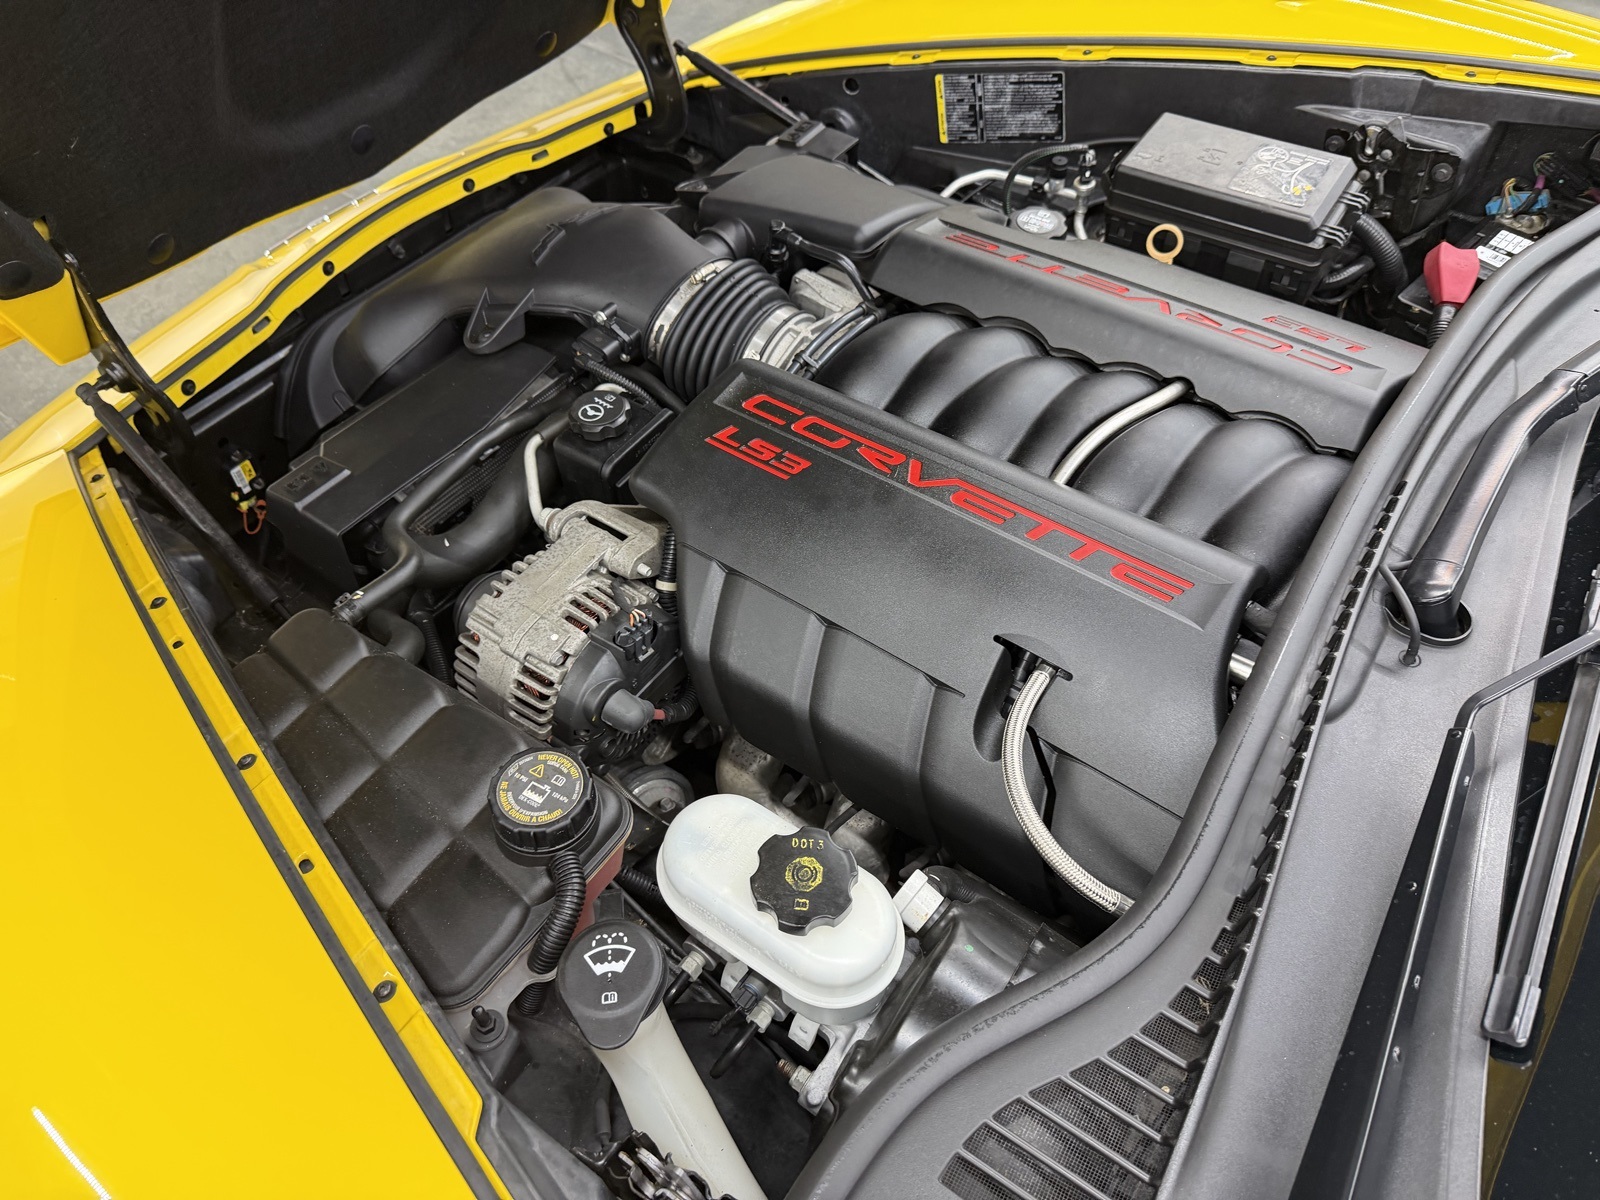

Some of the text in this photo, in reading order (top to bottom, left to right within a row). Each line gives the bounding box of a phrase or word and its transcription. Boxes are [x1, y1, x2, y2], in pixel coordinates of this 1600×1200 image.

[945, 233, 1353, 375] CORVETTE
[1263, 314, 1372, 353] LS3
[705, 425, 812, 480] LS3
[741, 393, 1195, 603] CORVETTE
[558, 757, 573, 769] OPEN
[500, 790, 512, 811] JAMAIS
[509, 809, 531, 823] OUVRIR
[791, 837, 824, 849] DOT 3
